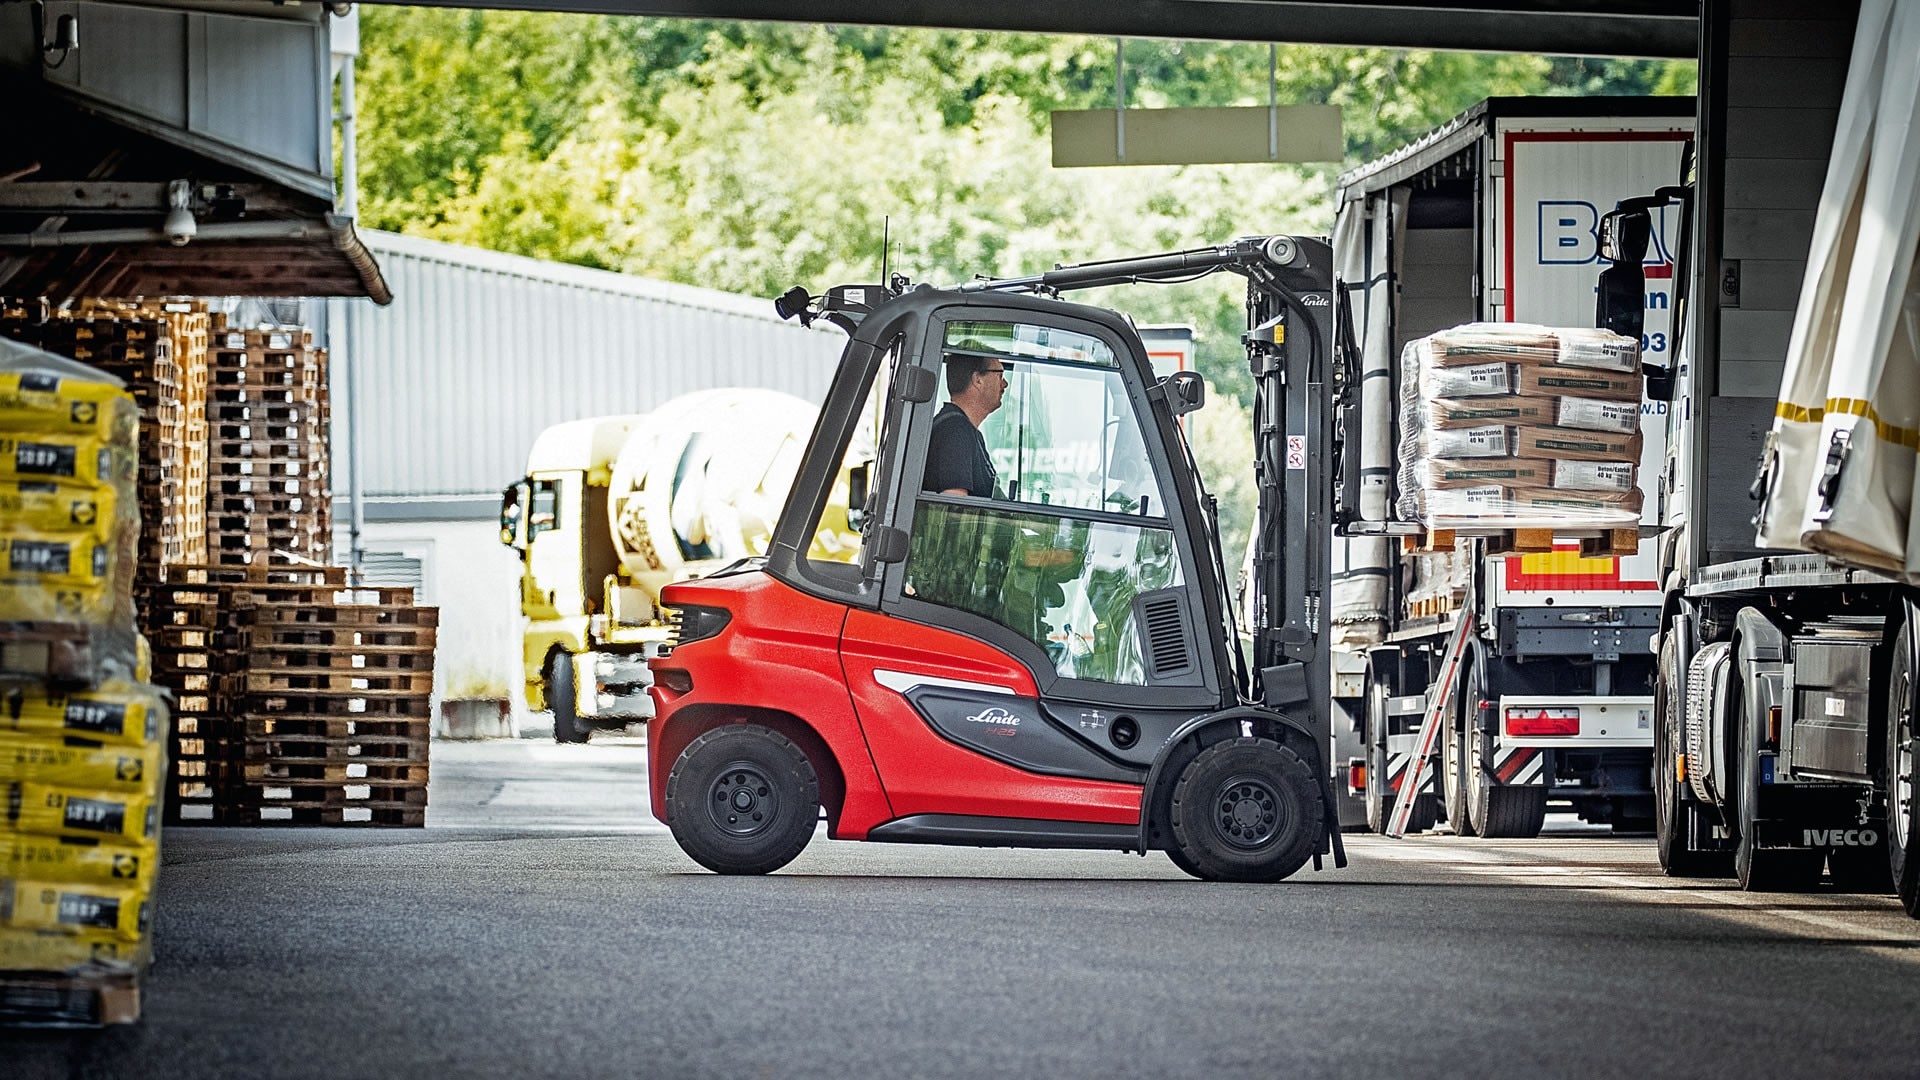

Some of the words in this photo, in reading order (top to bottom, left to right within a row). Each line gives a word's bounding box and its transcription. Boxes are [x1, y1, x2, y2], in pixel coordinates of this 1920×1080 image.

[1470, 367, 1504, 376] Beton/Estrich
[1602, 405, 1636, 414] Beton/Estrich
[1597, 465, 1631, 474] Beton/Estrich
[1466, 489, 1500, 497] Beton/Estrich
[966, 707, 1021, 726] Linde
[1803, 829, 1878, 846] IVECO
